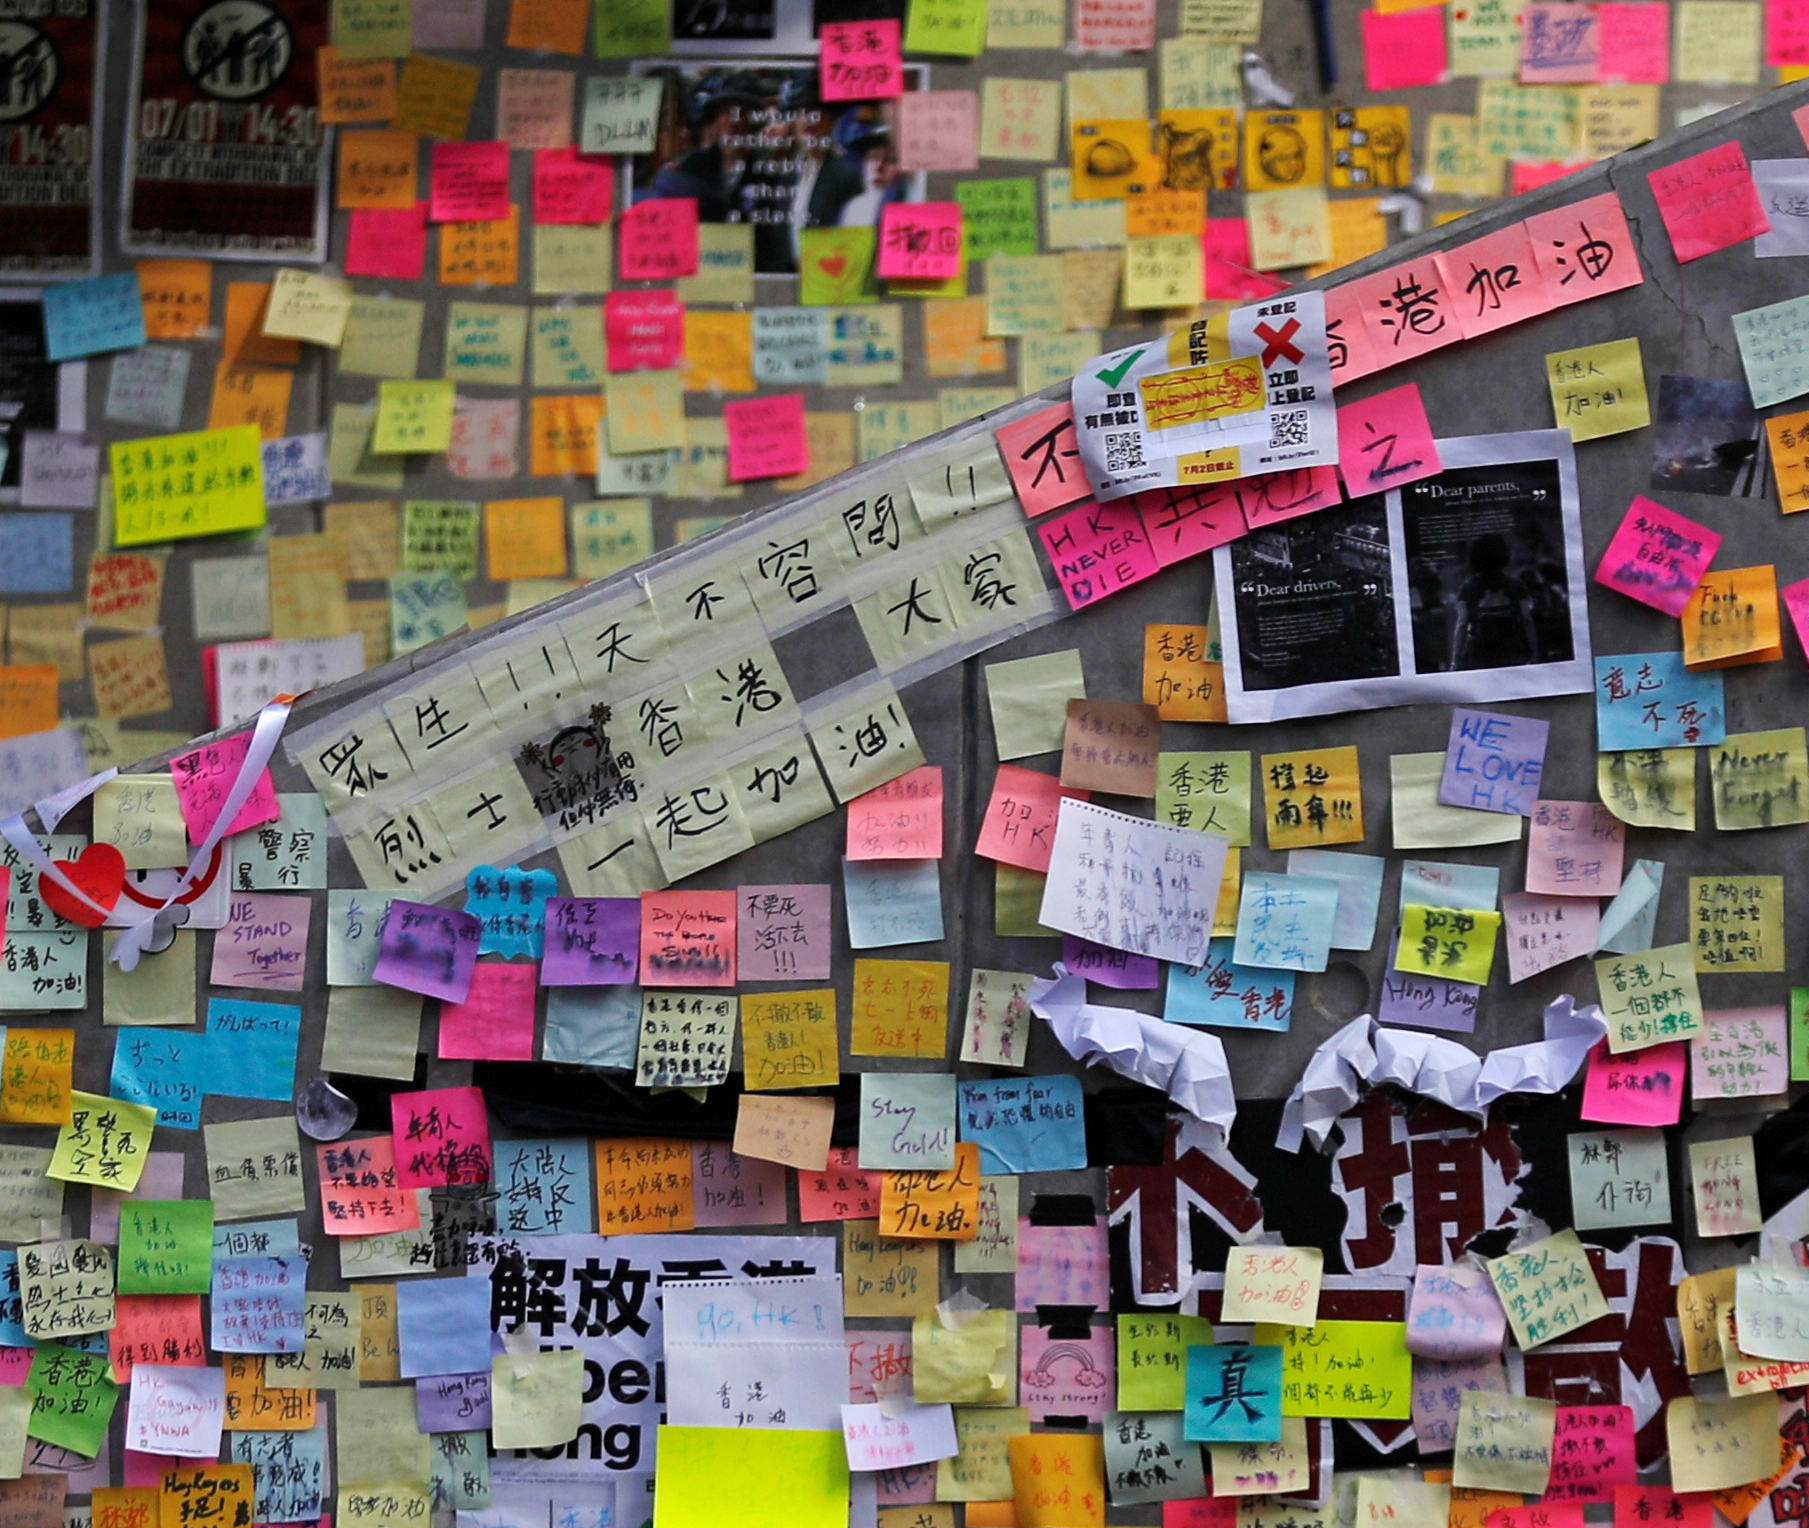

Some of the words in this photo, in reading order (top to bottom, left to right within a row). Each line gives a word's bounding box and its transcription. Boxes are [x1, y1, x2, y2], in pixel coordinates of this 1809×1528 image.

[1268, 387, 1316, 405] 上登記
[1431, 484, 1464, 499] Dear
[1061, 528, 1142, 578] NEVER
[1257, 582, 1290, 597] Dear
[1459, 717, 1511, 747] WE
[1457, 746, 1542, 786] LOVE
[1472, 783, 1526, 811] HK
[233, 918, 292, 941] STAND
[3, 942, 58, 974] 香港人
[32, 973, 83, 995] 加油!
[1198, 1348, 1268, 1429] 真
